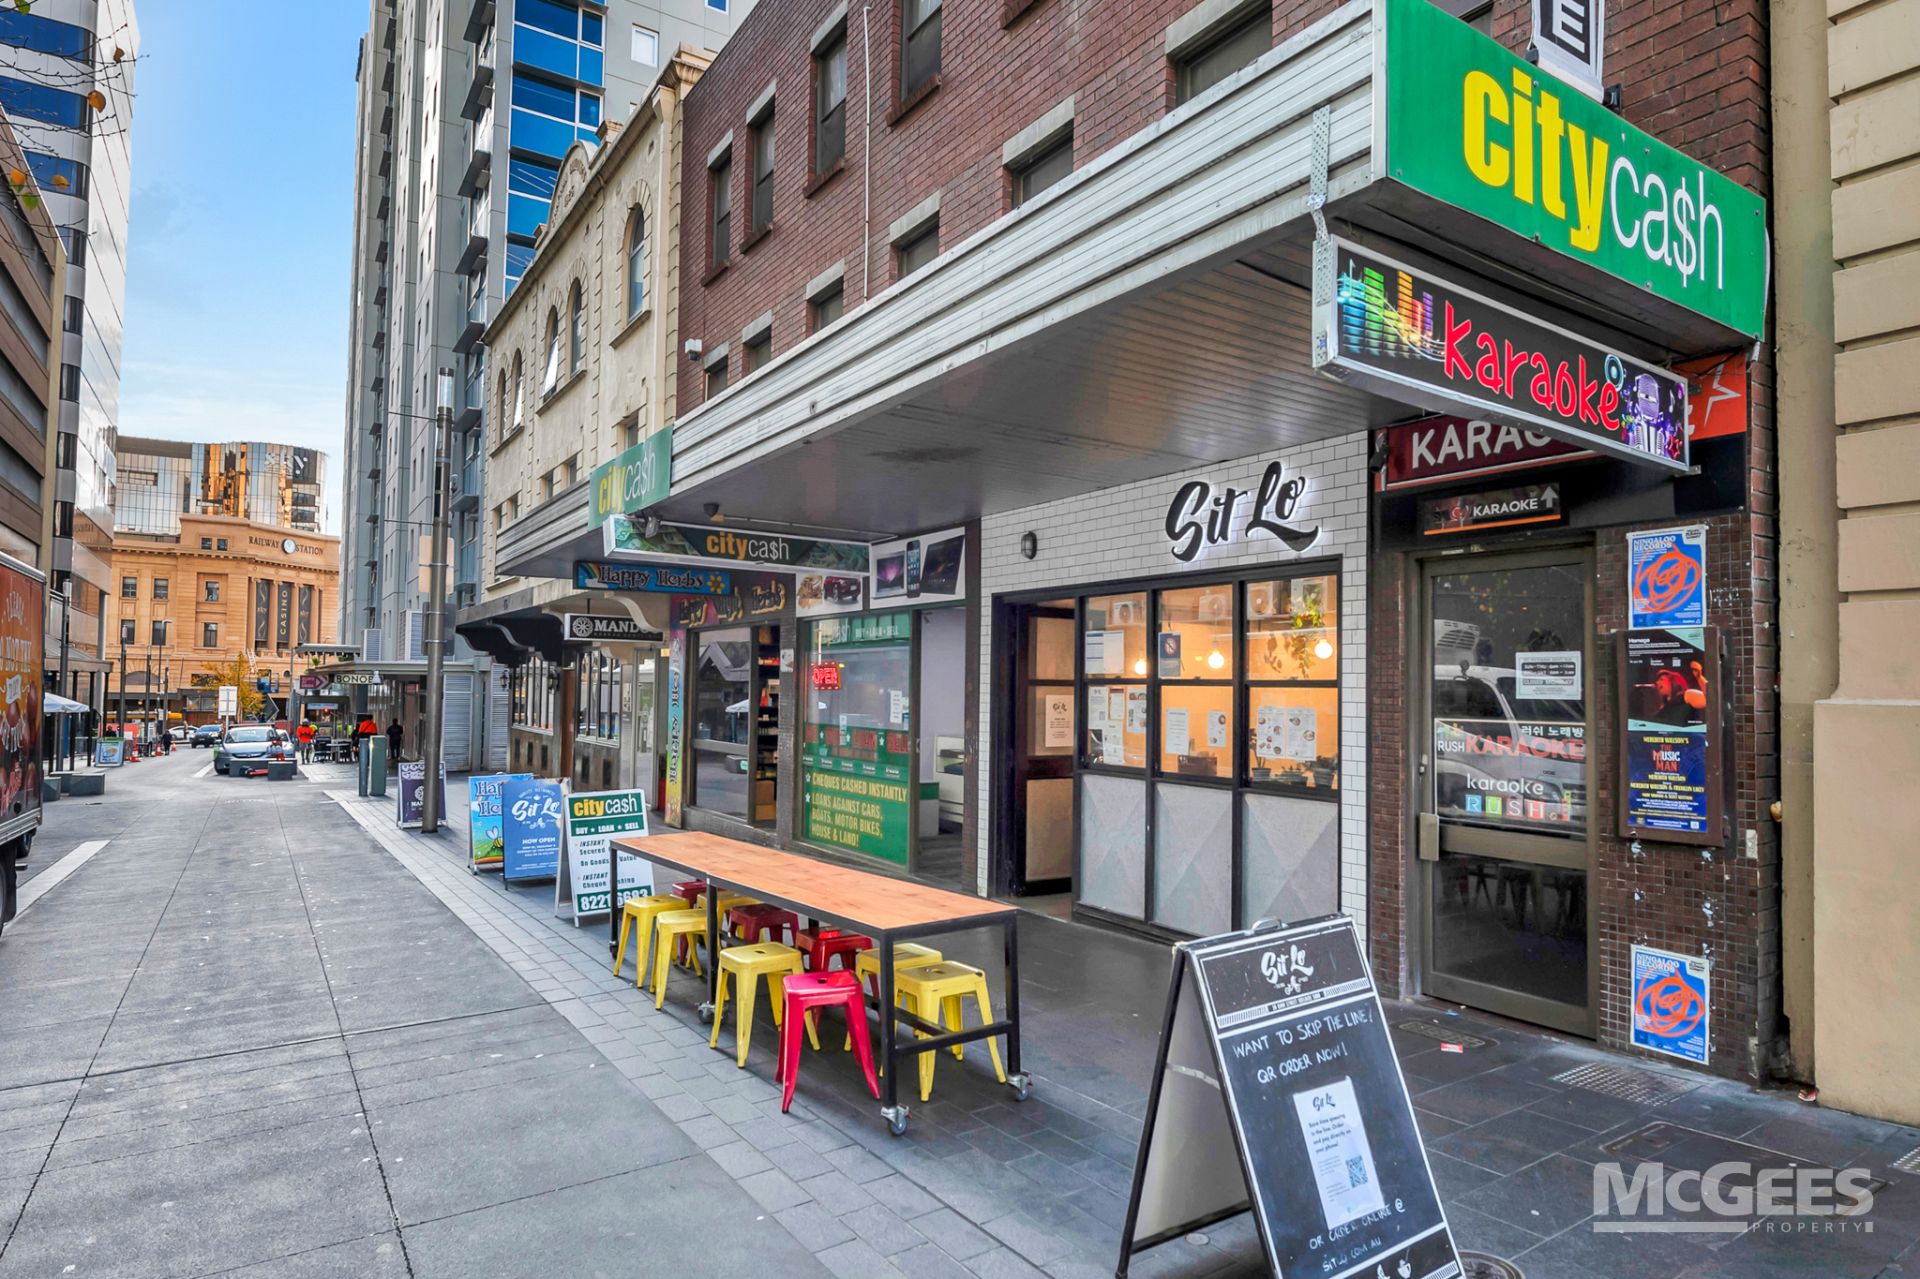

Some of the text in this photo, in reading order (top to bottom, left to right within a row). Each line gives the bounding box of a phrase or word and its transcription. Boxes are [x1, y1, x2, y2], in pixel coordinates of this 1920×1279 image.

[1444, 301, 1621, 431] karaoke
[1412, 420, 1552, 469] KARA
[1166, 460, 1319, 562] Sit Lo
[1473, 498, 1538, 517] KARAOKE
[248, 536, 323, 555] RAILWAY STATION
[1634, 535, 1676, 546] NINGALOO
[1634, 542, 1672, 552] RECORDS
[599, 566, 703, 587] Happy Herbs
[280, 590, 288, 635] CASINO
[594, 619, 650, 633] MAND
[335, 674, 381, 684] BONOB
[812, 668, 837, 684] OPEN
[1521, 725, 1584, 737] 러쉬 노래방
[1438, 735, 1585, 759] RUSH KARAOKE
[1653, 750, 1680, 761] MUSIC
[1656, 760, 1678, 772] MAN
[476, 782, 502, 798] Hap
[813, 772, 907, 802] CHEQUES CASHED INSTANTLY
[1467, 773, 1544, 795] karaoke
[512, 800, 541, 821] Sit
[541, 798, 561, 819] Lo
[812, 792, 831, 808] LOANS
[833, 796, 860, 815] AGAINST
[598, 825, 614, 833] LOAN
[624, 822, 639, 830] SELL
[834, 813, 858, 831] MOTOR
[812, 823, 831, 839] HOUSE
[832, 828, 837, 841] &
[580, 839, 605, 847] INSTANT
[580, 847, 606, 855] Secured
[582, 872, 608, 880] INSTANT
[1261, 951, 1289, 984] Sit
[1290, 944, 1314, 976] Lo
[1636, 953, 1680, 968] NINGALOO
[1232, 1035, 1269, 1058] WANT
[1276, 1029, 1293, 1045] TO
[1297, 1020, 1322, 1041] SKIP
[1324, 1015, 1344, 1032] THE
[1257, 1041, 1348, 1084] QR ORDER NOW!
[1309, 1235, 1324, 1250] OR
[1361, 1204, 1392, 1227] ONLINE
[1394, 1197, 1406, 1213] @
